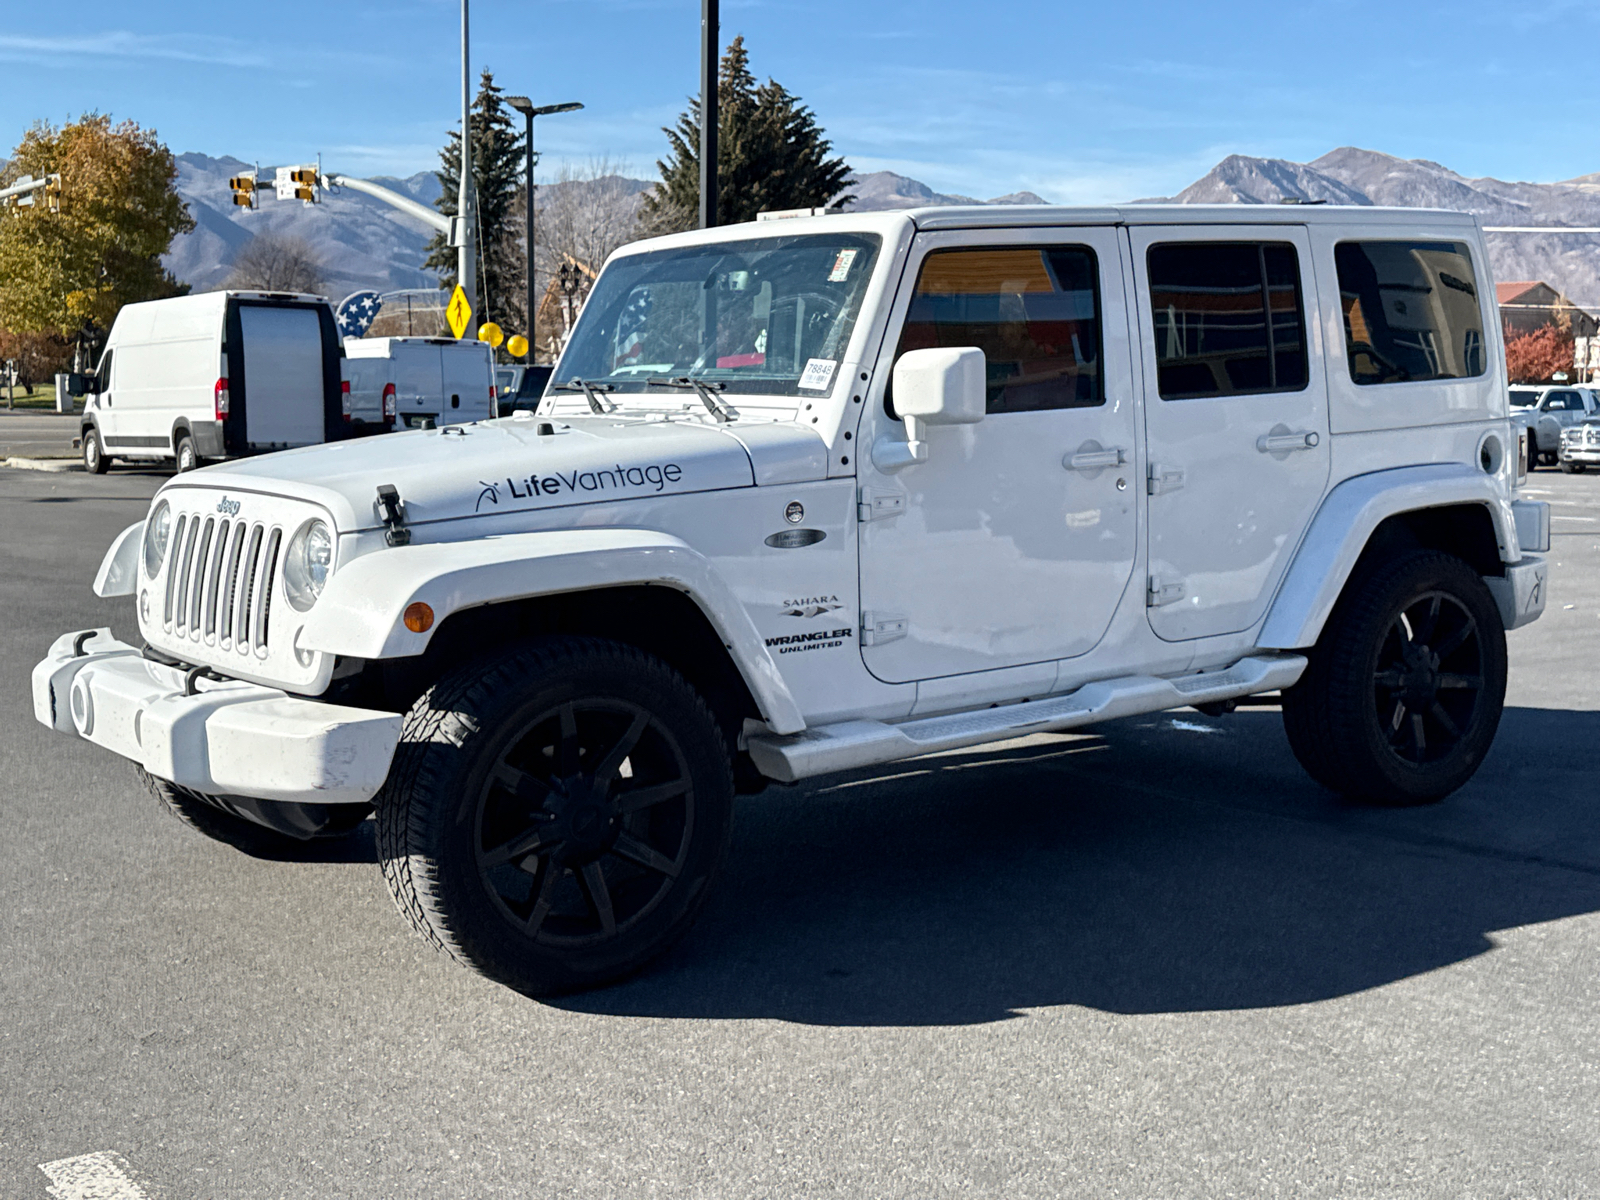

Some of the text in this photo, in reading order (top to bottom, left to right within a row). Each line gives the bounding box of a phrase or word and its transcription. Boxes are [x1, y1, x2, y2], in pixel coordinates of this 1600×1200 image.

[506, 463, 683, 499] LifeVantage
[216, 495, 241, 518] Jeep
[783, 595, 839, 608] SAHARA
[765, 628, 852, 647] WRANGLER
[779, 641, 842, 654] UNLIMITED
